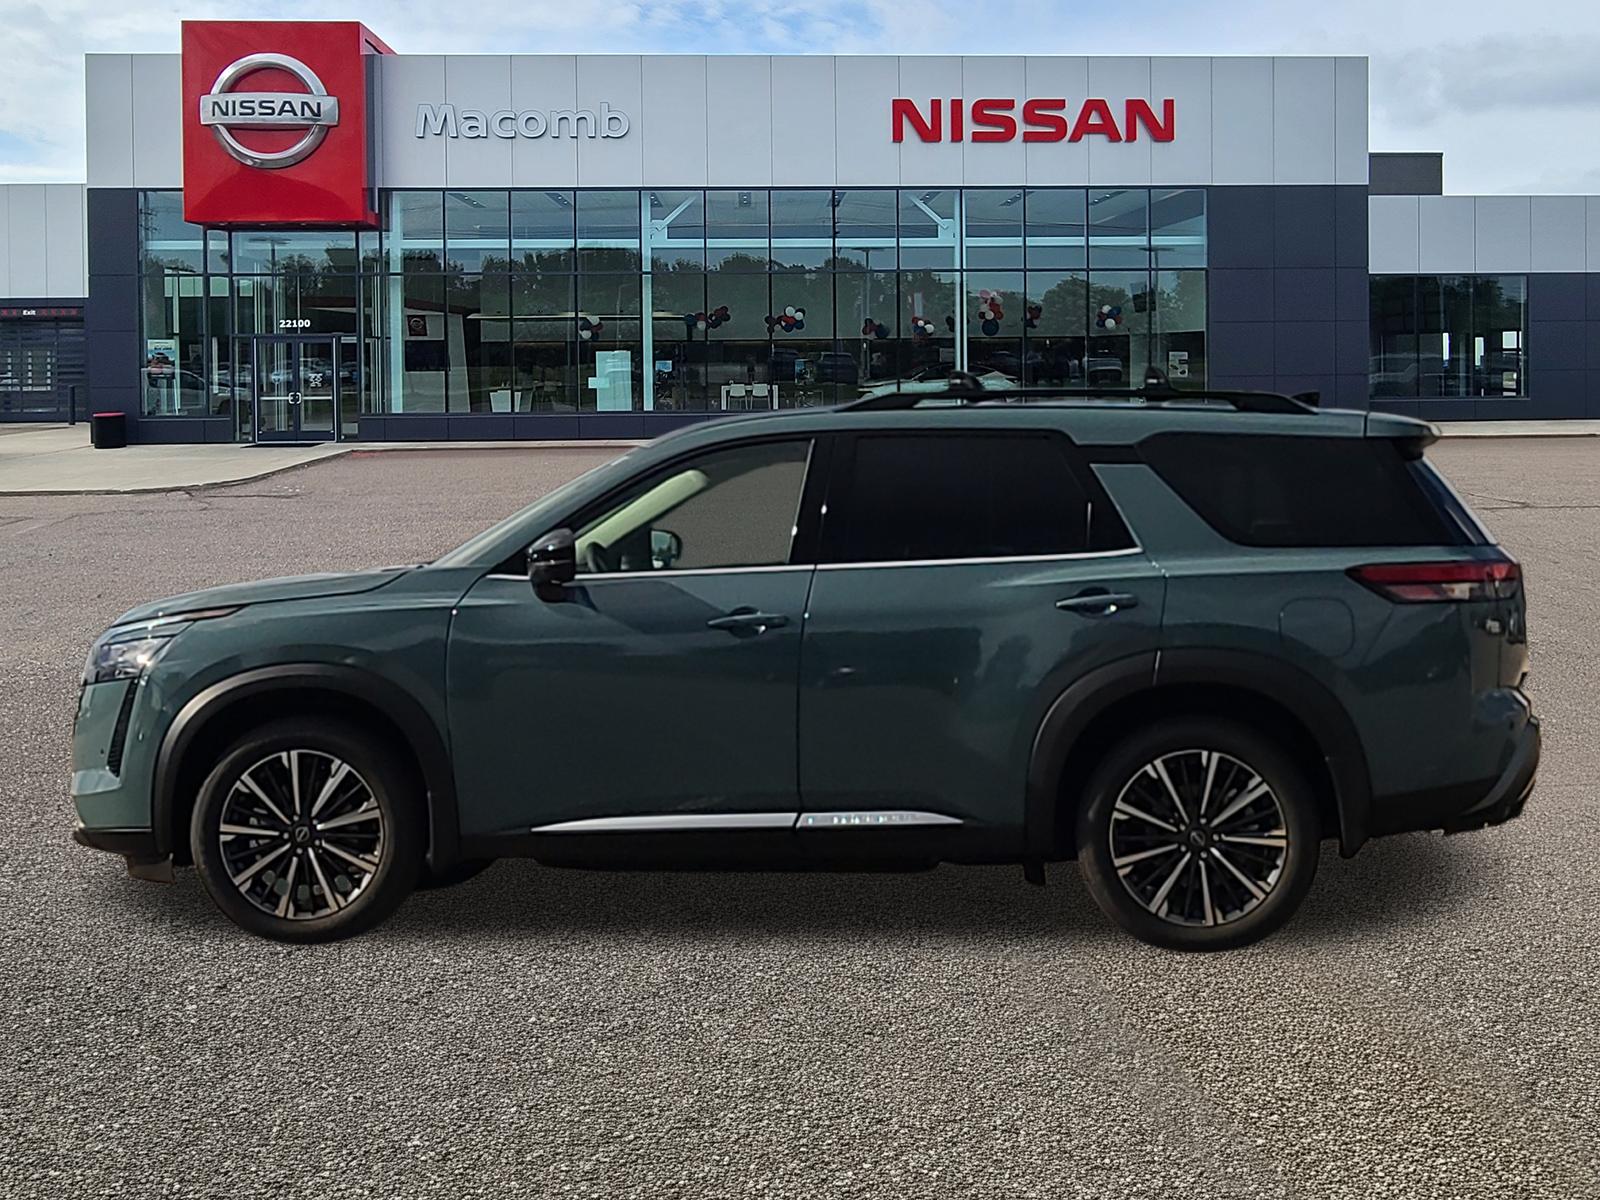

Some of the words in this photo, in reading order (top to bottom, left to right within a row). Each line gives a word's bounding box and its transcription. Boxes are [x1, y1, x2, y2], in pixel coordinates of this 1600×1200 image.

[212, 100, 322, 117] NISSAN
[415, 102, 630, 138] Macomb
[892, 98, 1175, 143] NISSAN
[279, 319, 311, 328] 22100
